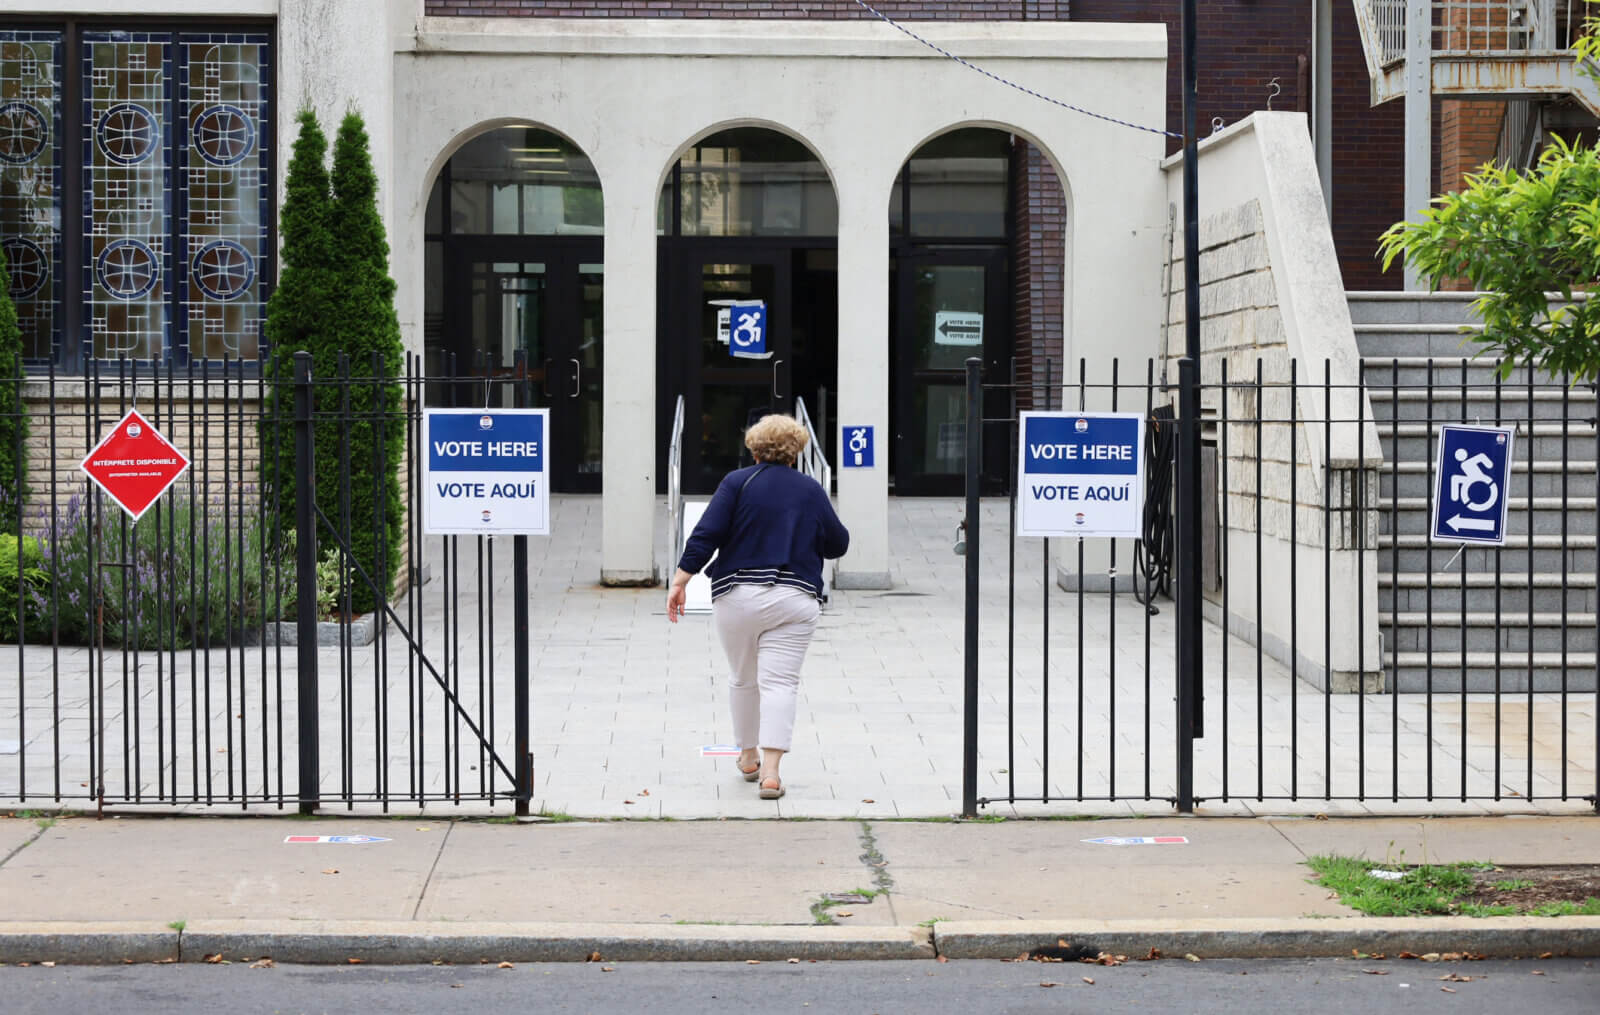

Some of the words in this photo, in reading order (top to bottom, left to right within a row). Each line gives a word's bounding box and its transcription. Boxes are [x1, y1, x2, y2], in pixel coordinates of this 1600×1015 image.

[434, 441, 482, 457] VOTE
[487, 441, 538, 457] HERE
[1030, 443, 1077, 460] VOTE
[1082, 444, 1133, 460] HERE
[136, 458, 177, 466] DISPONIBLE
[437, 483, 485, 498] VOTE
[490, 479, 536, 499] AQUÍ
[1032, 485, 1079, 501] VOTE
[1084, 482, 1130, 501] AQUÍ
